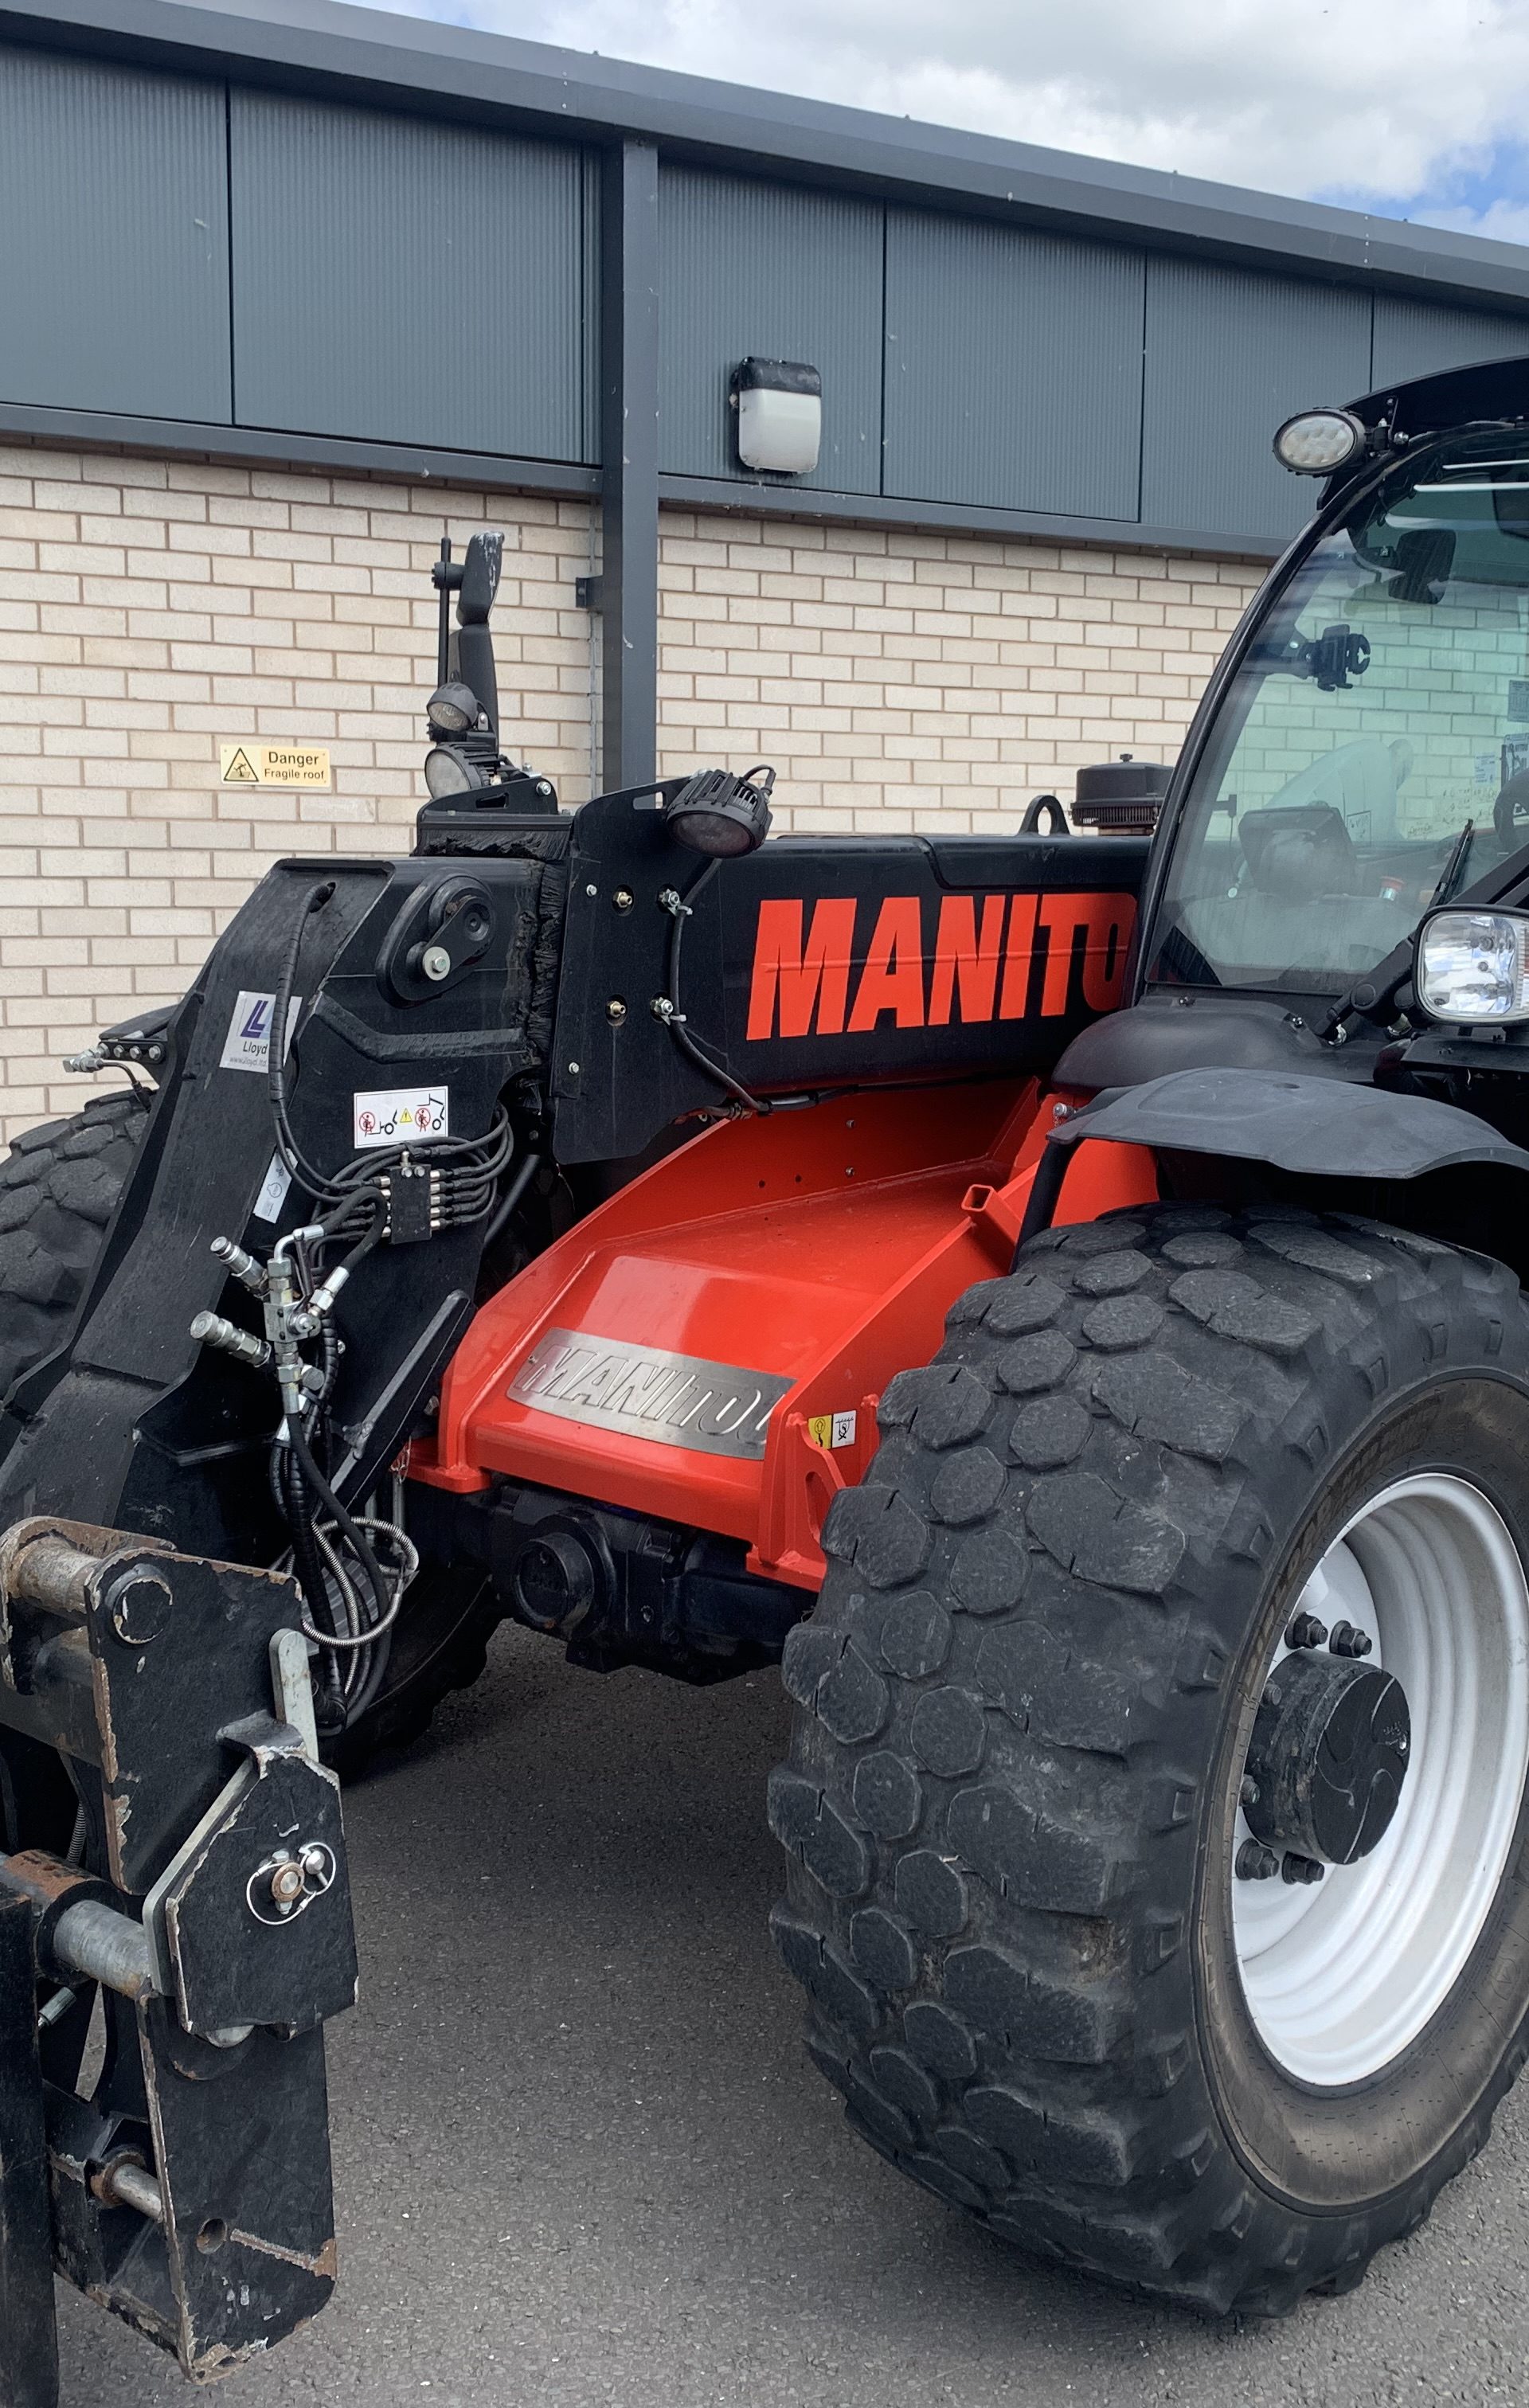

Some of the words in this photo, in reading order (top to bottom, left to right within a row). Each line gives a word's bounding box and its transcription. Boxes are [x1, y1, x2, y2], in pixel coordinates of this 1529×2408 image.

[268, 751, 319, 768] Danger
[264, 768, 300, 780] Fragile
[303, 770, 325, 780] roof
[243, 1041, 268, 1057] Lloyd
